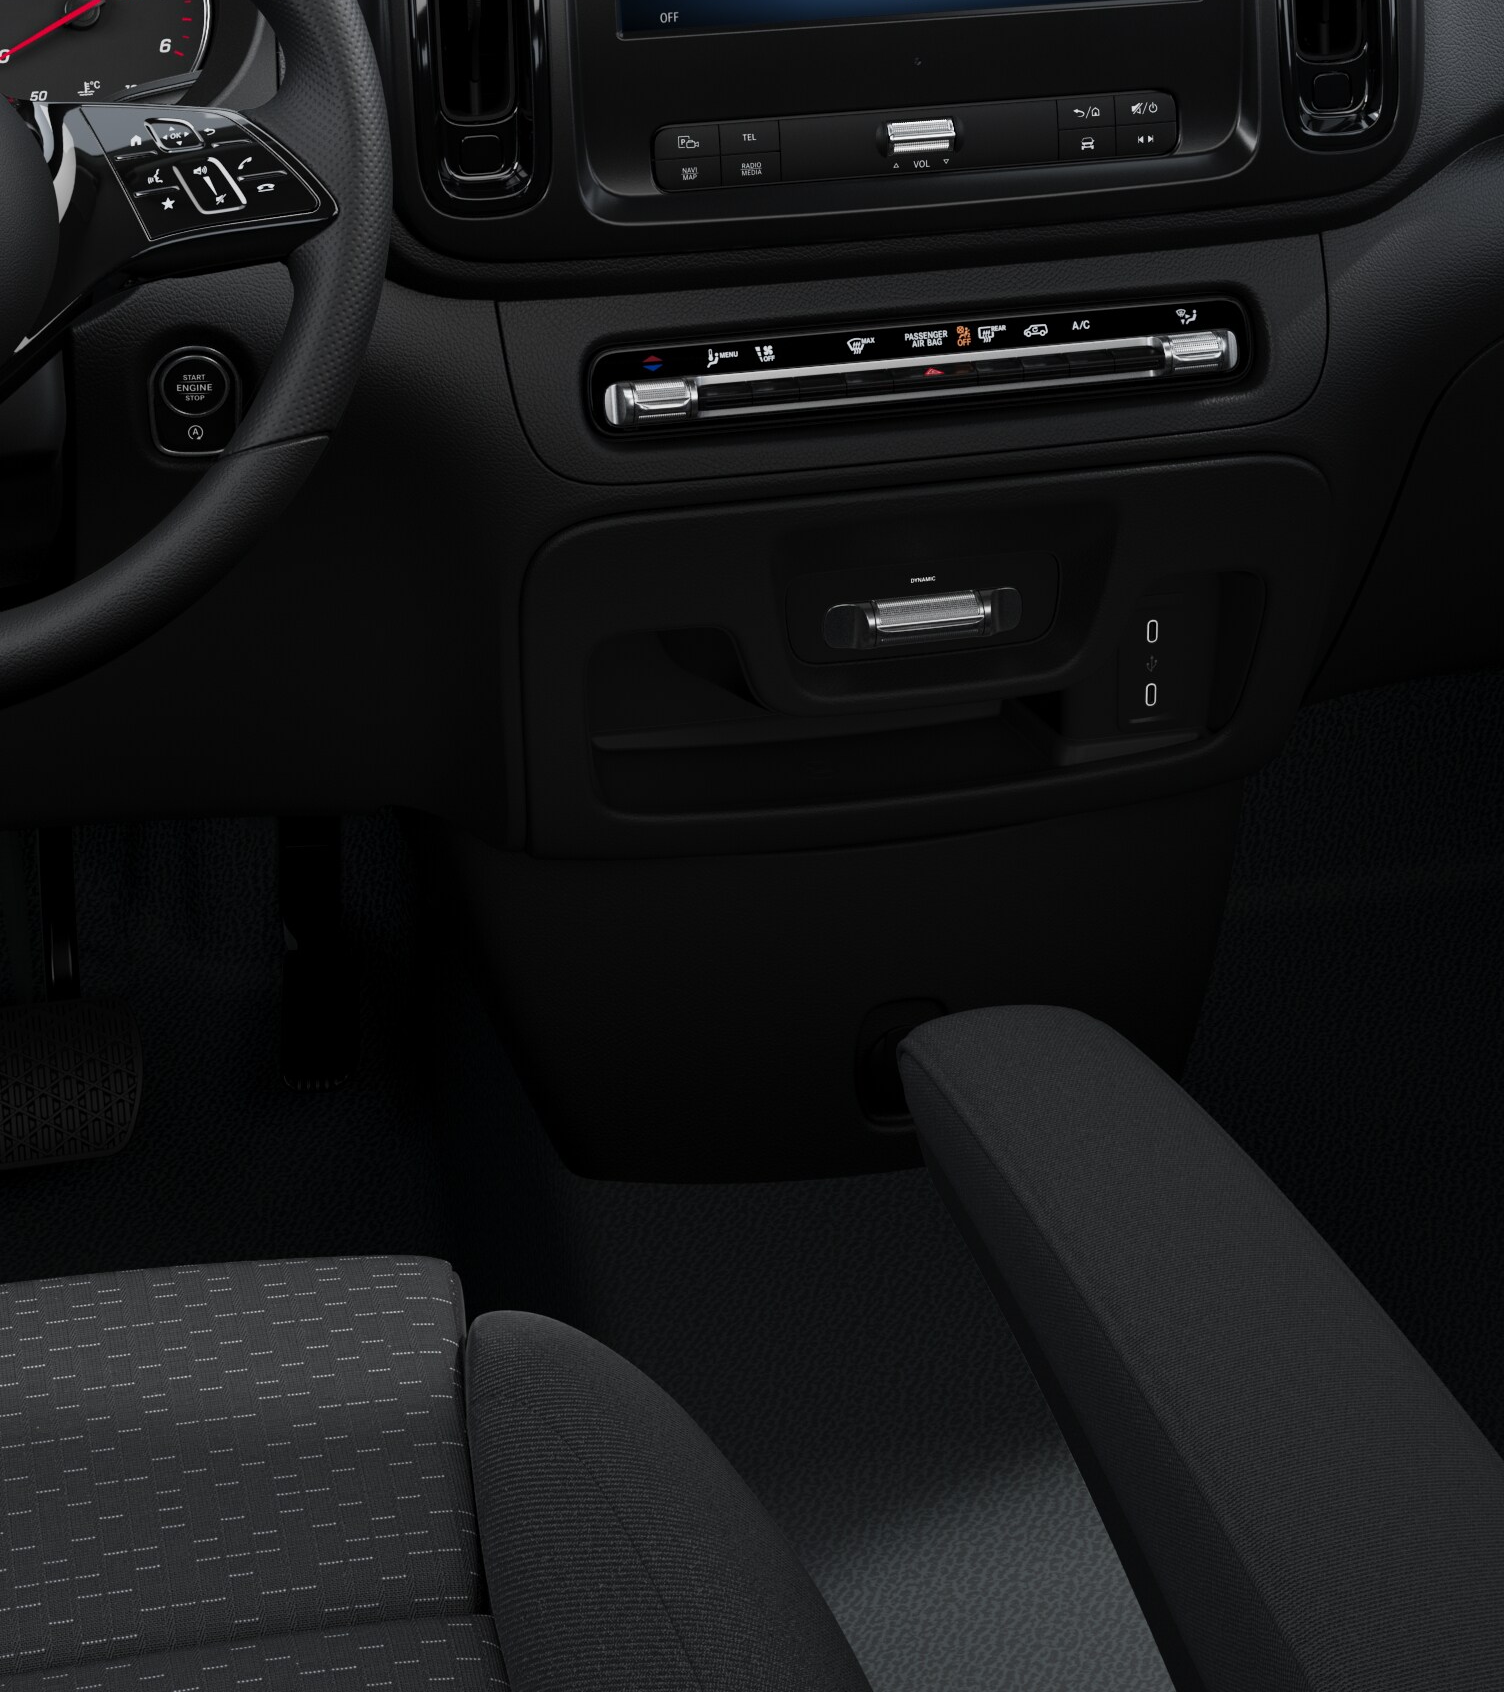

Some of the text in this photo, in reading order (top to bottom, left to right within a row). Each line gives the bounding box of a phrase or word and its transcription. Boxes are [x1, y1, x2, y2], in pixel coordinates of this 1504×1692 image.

[660, 11, 679, 24] OFF
[159, 38, 172, 54] 6
[30, 91, 48, 102] 50
[170, 132, 182, 140] OK
[742, 134, 757, 142] TEL
[913, 159, 931, 170] VOL
[1072, 320, 1091, 331] A/C
[904, 330, 948, 341] PASSENGER
[860, 336, 876, 345] MAX
[912, 338, 943, 348] AIR BAG
[957, 338, 972, 347] OFF
[719, 351, 739, 359] MENU
[763, 354, 775, 363] OFF
[176, 383, 213, 393] ENGINE
[185, 394, 206, 402] STOP
[910, 576, 936, 584] DYNAMIC
